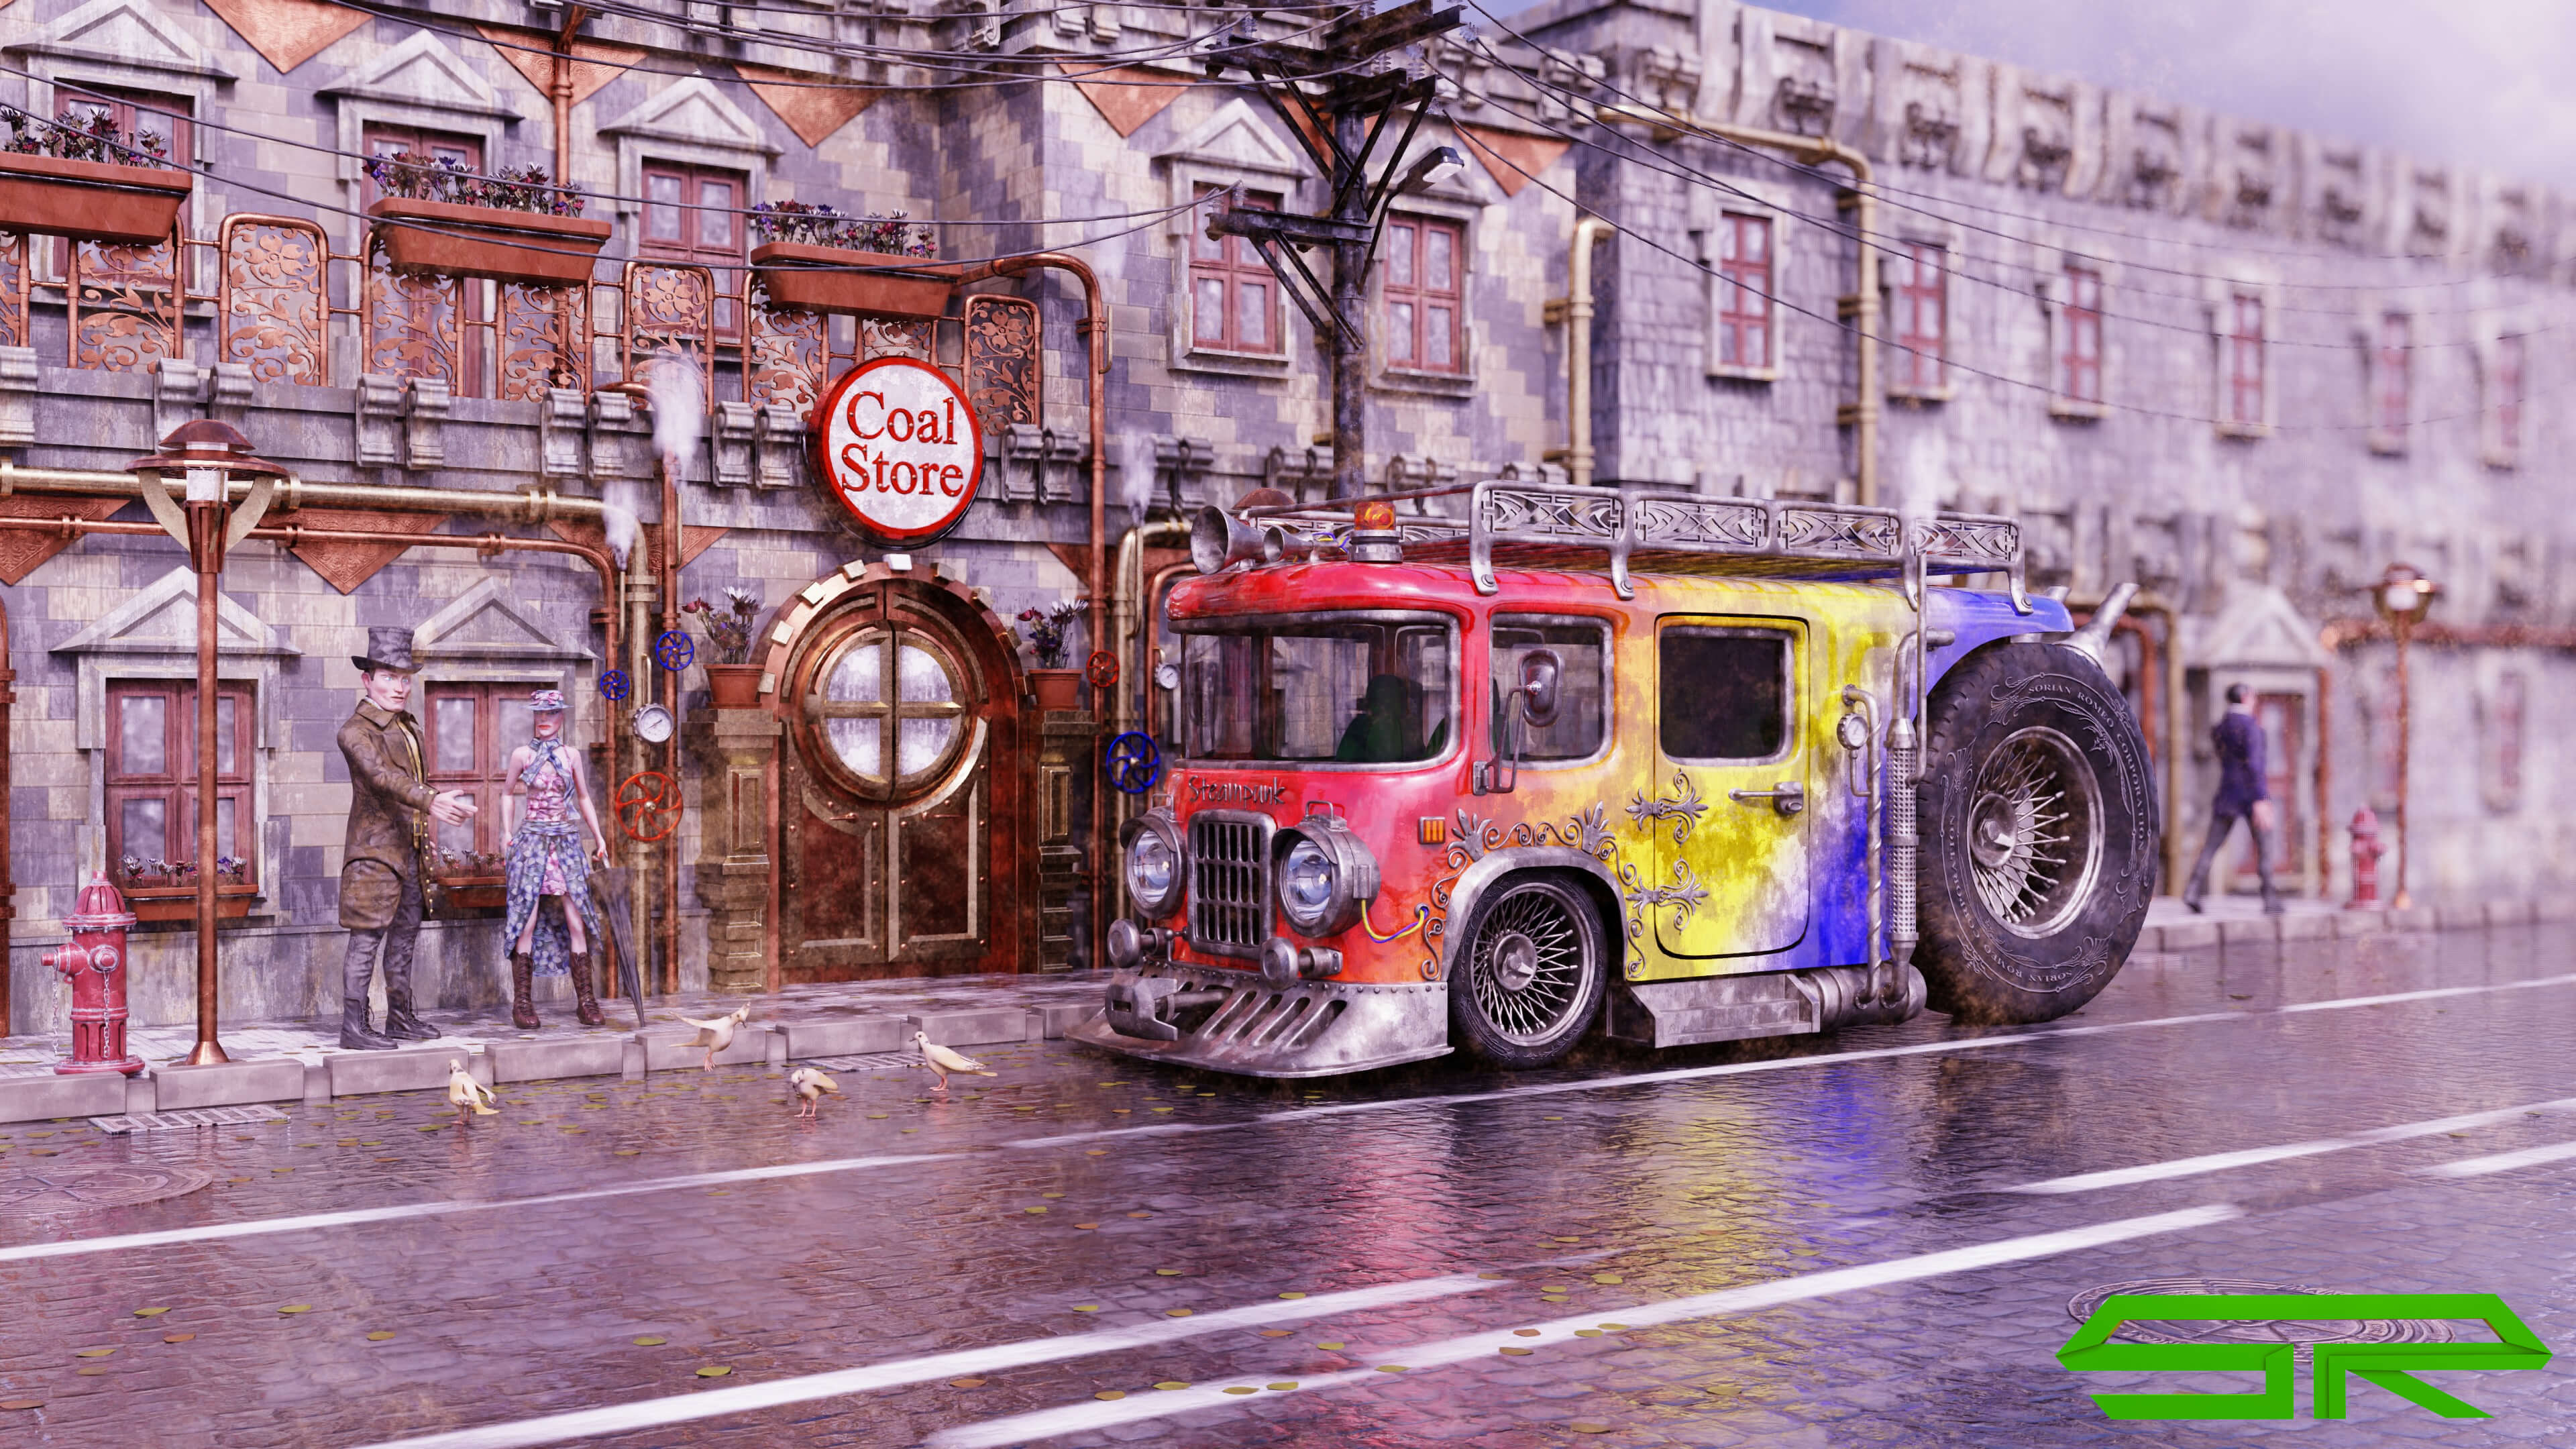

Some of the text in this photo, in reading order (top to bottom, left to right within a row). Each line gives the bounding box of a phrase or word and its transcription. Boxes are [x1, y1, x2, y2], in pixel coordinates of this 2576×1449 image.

[847, 391, 958, 445] Coal
[841, 443, 964, 497] Store
[1188, 775, 1287, 811] Steampunk
[2028, 684, 2145, 851] SORIAN ROMEO CORPORATION
